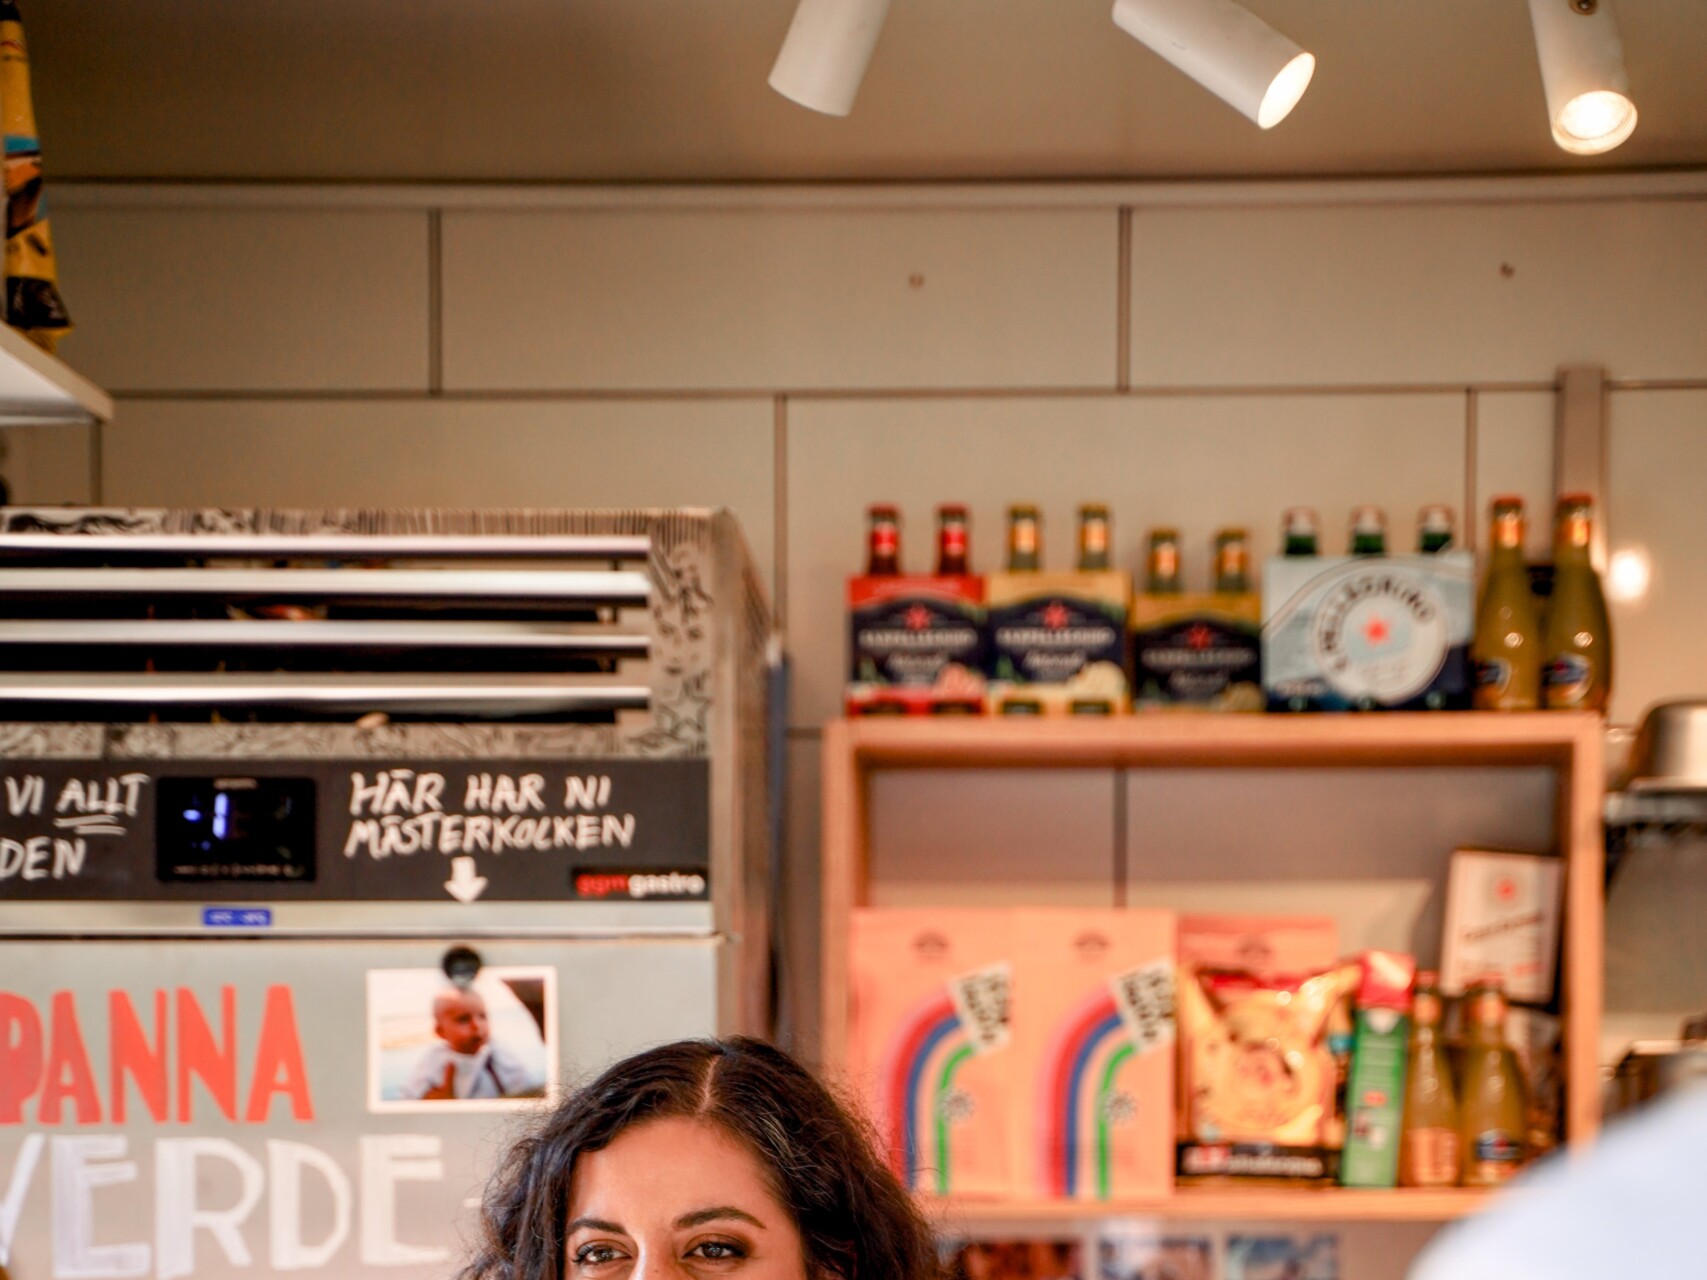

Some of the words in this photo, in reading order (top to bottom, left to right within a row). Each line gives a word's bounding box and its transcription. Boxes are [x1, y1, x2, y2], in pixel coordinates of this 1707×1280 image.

[5, 774, 45, 817] VI
[55, 772, 151, 817] ALLT
[464, 772, 546, 813] HAR
[564, 775, 611, 811] NI
[0, 835, 87, 880] DEN
[0, 984, 314, 1126] PANNA
